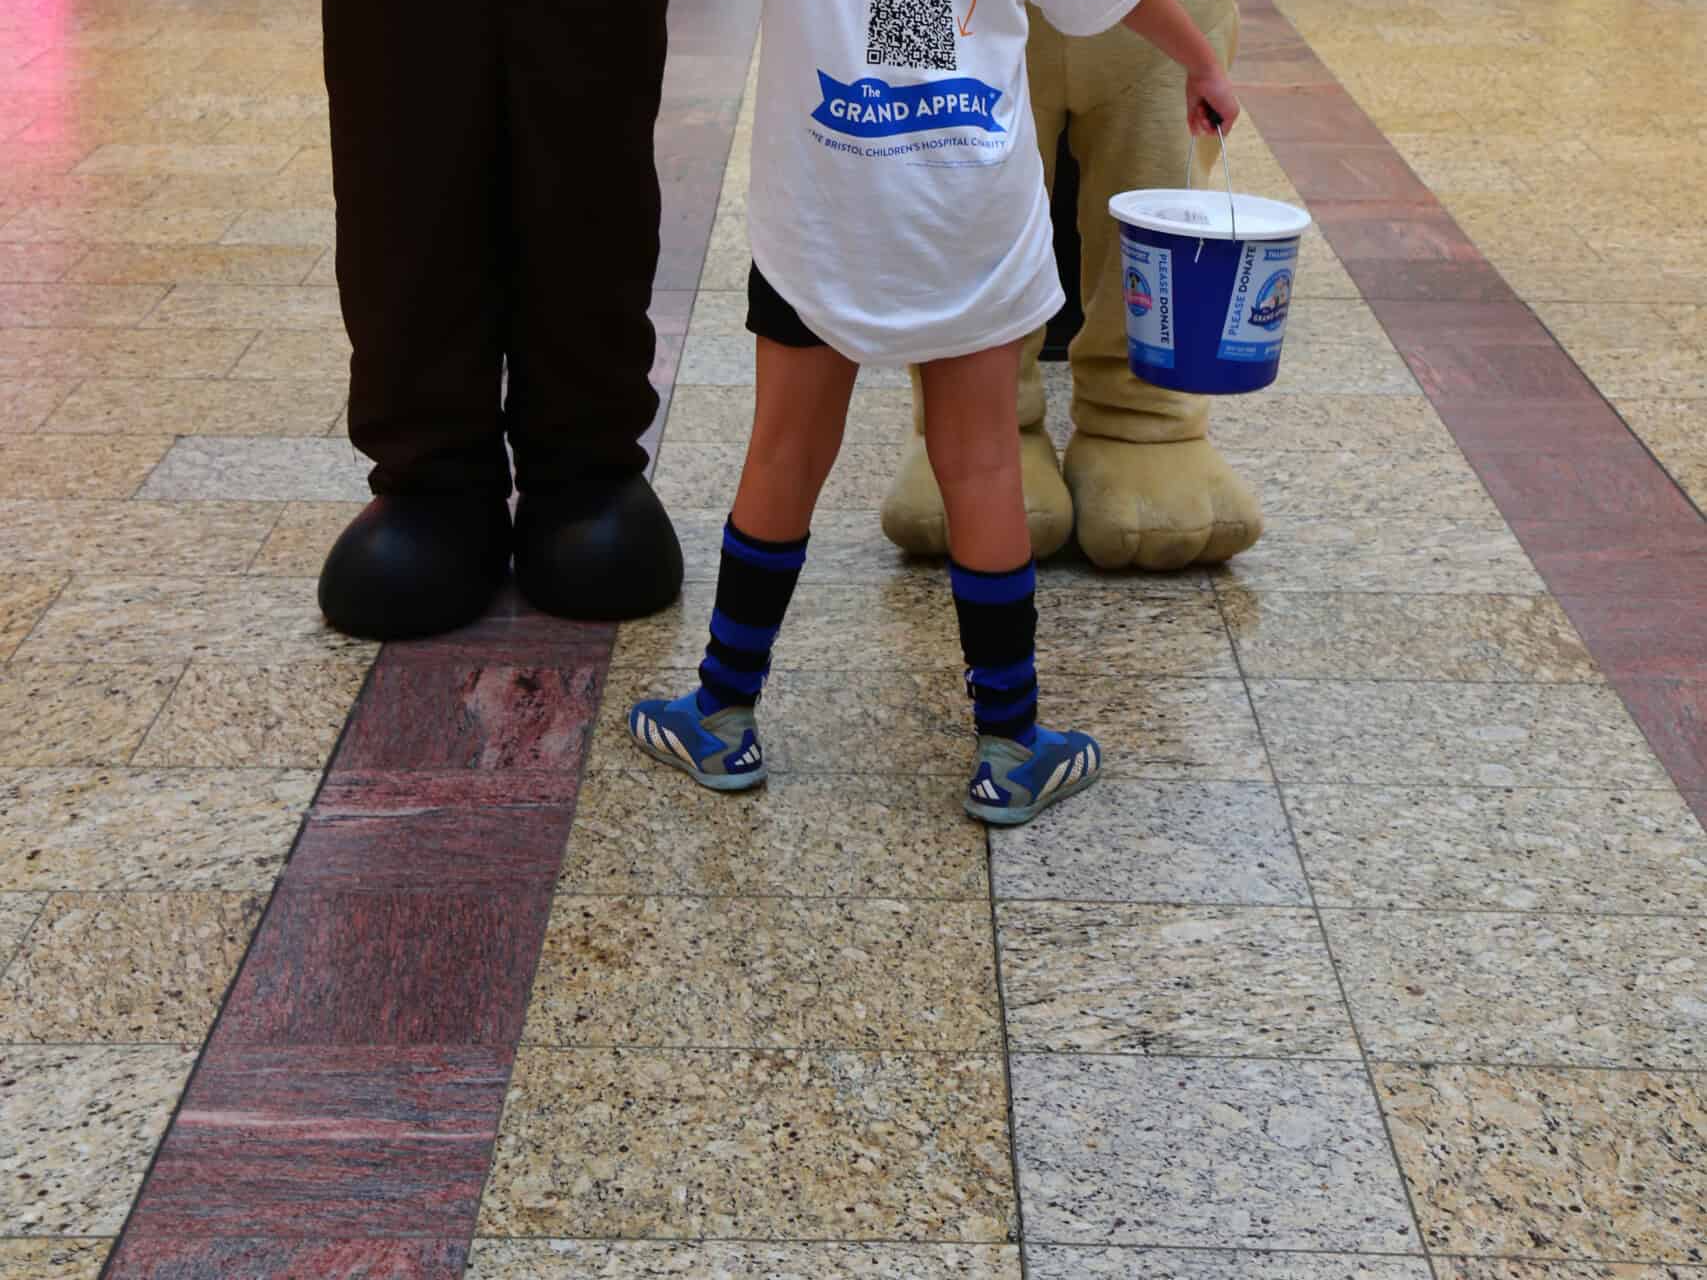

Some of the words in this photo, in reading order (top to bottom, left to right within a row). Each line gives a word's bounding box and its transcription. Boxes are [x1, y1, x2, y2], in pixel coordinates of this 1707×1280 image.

[830, 98, 910, 124] GRAND
[916, 93, 988, 118] APPEAL
[862, 84, 881, 98] The
[825, 138, 864, 156] BRISTOL
[865, 142, 920, 158] CHILDREN'S
[921, 137, 969, 150] HOSPITAL
[1158, 253, 1169, 296] PLEASE
[1228, 295, 1246, 336] PLEASE
[1238, 246, 1257, 293] DONATE
[1159, 297, 1170, 345] DONATE
